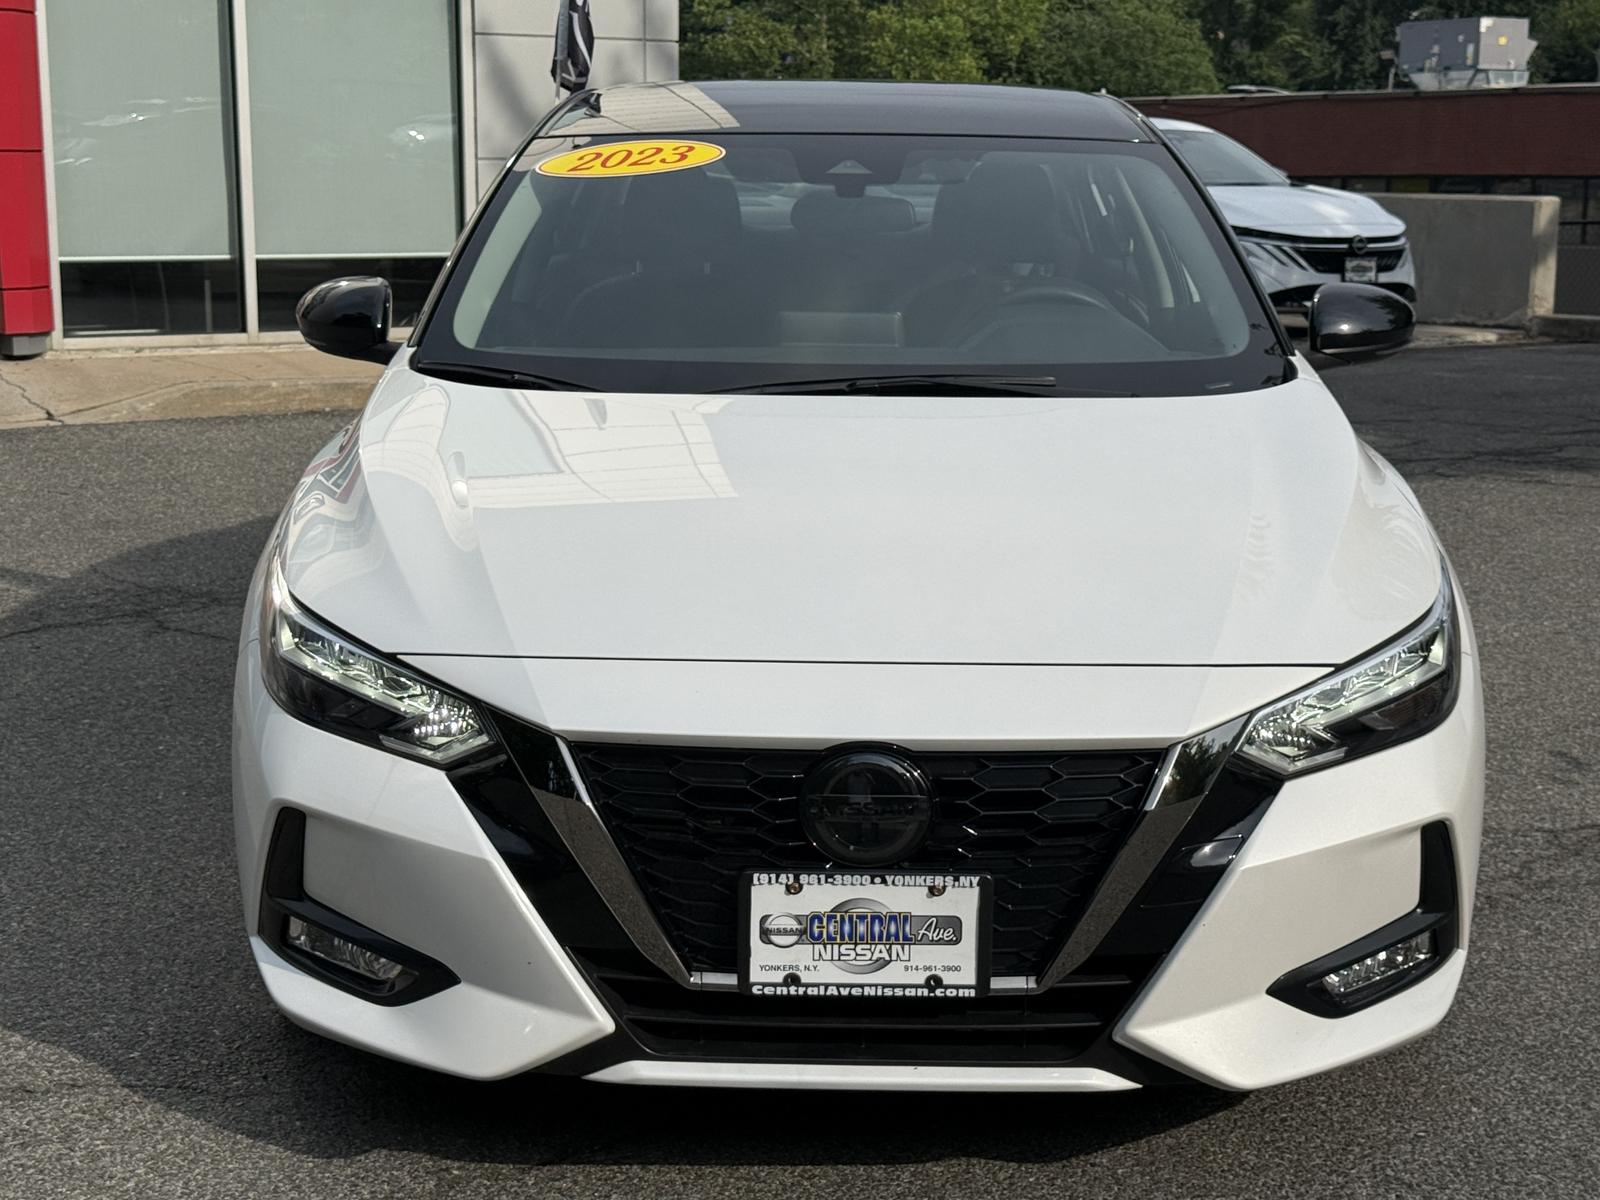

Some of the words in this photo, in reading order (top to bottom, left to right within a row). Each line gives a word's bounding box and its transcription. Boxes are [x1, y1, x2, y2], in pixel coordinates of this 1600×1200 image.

[566, 145, 696, 173] 2023
[799, 874, 871, 887] 961-3900
[766, 926, 802, 934] NISSAN
[808, 912, 916, 943] CENTRAL
[917, 917, 957, 941] Ave.
[813, 944, 911, 961] NISSAN
[759, 964, 802, 972] YONKERS,
[804, 964, 820, 972] N.Y.
[751, 985, 976, 997] CentralAveNissan.com
